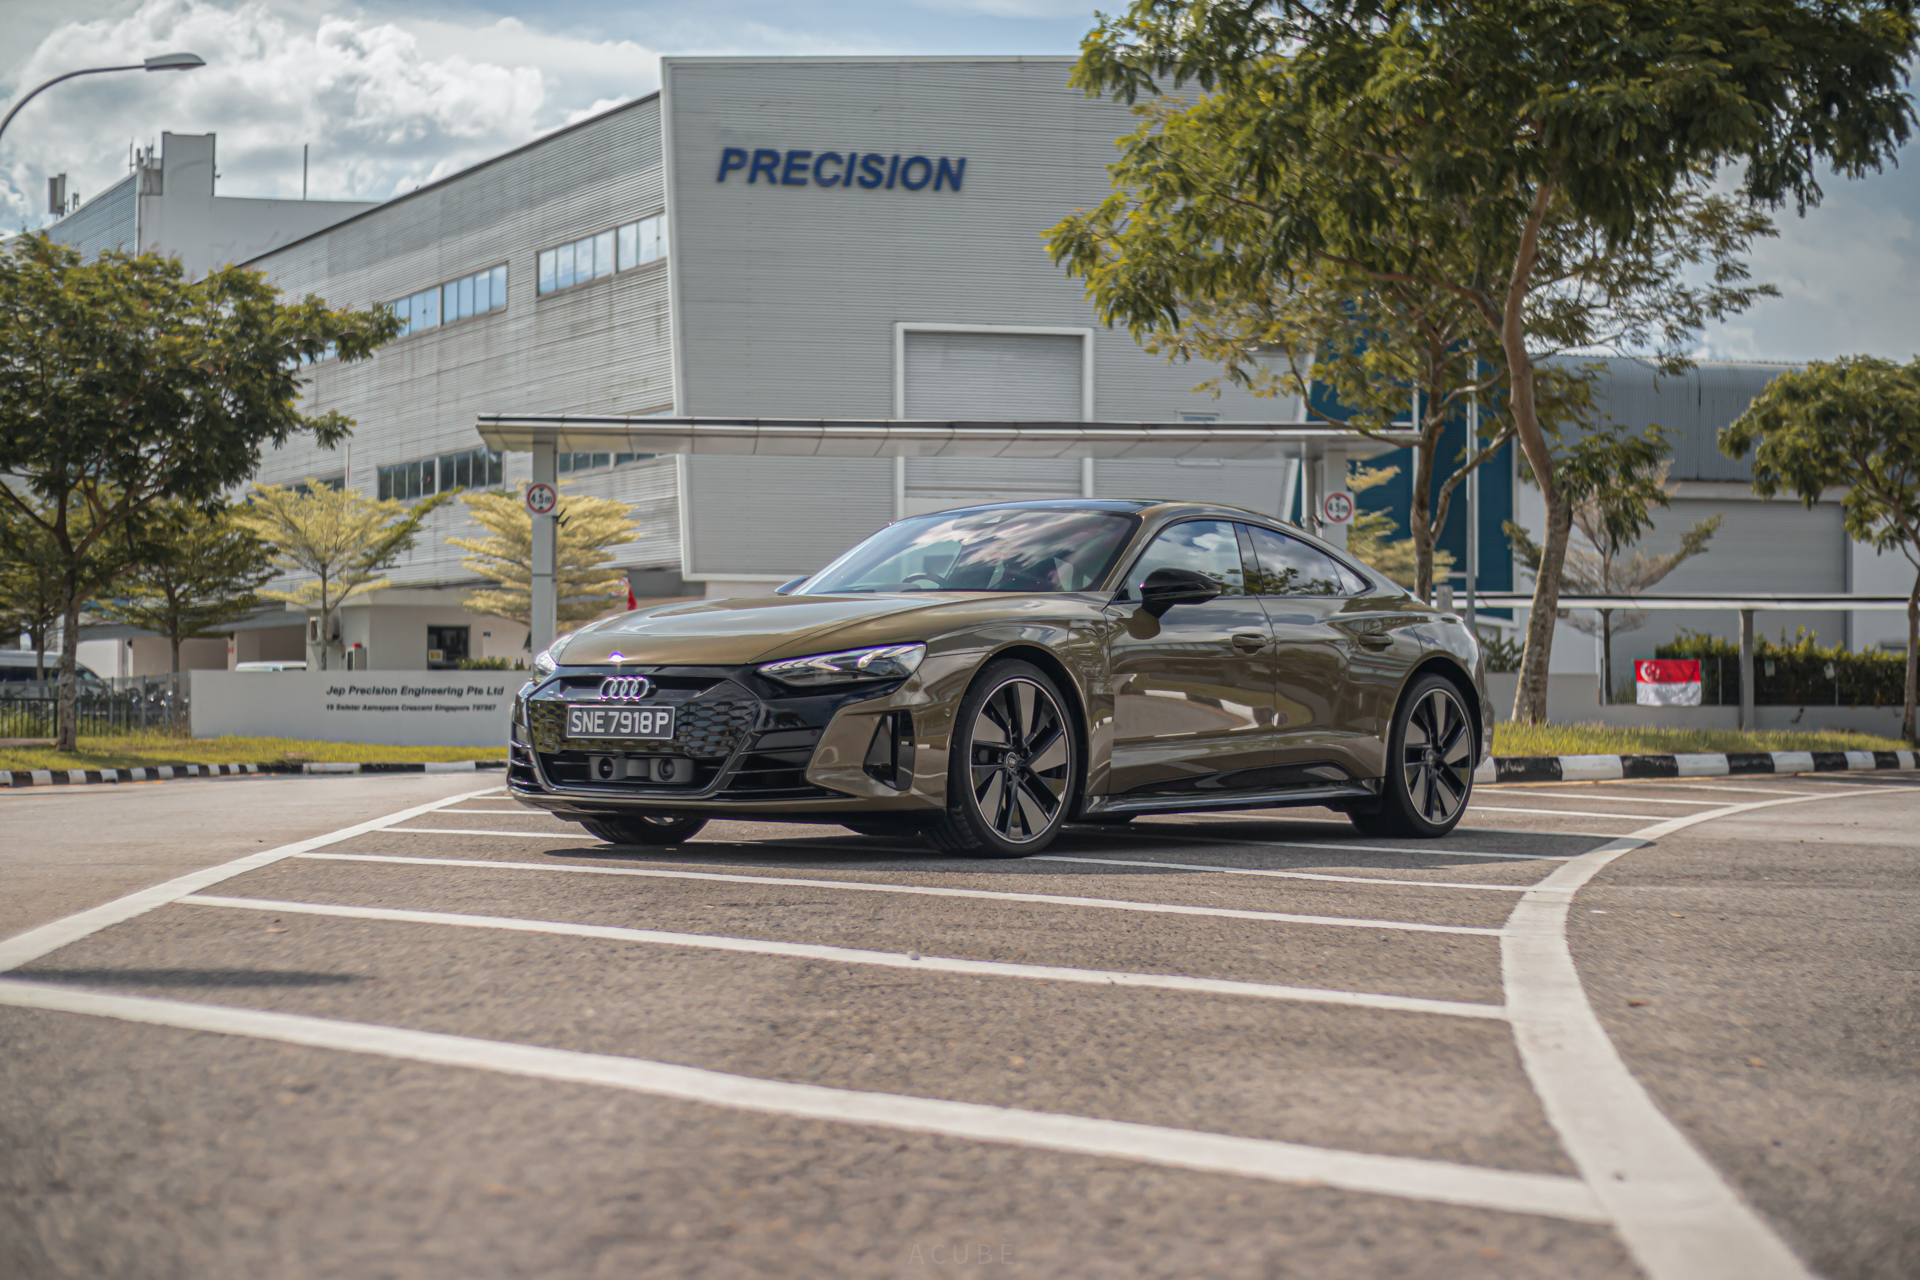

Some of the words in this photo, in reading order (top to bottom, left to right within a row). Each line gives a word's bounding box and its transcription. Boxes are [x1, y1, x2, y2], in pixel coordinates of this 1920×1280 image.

[717, 148, 967, 191] PRECISION
[326, 685, 346, 697] Jep
[348, 685, 398, 696] Precision
[401, 685, 464, 698] Engineering
[467, 685, 484, 696] Pte
[486, 685, 504, 696] Ltd
